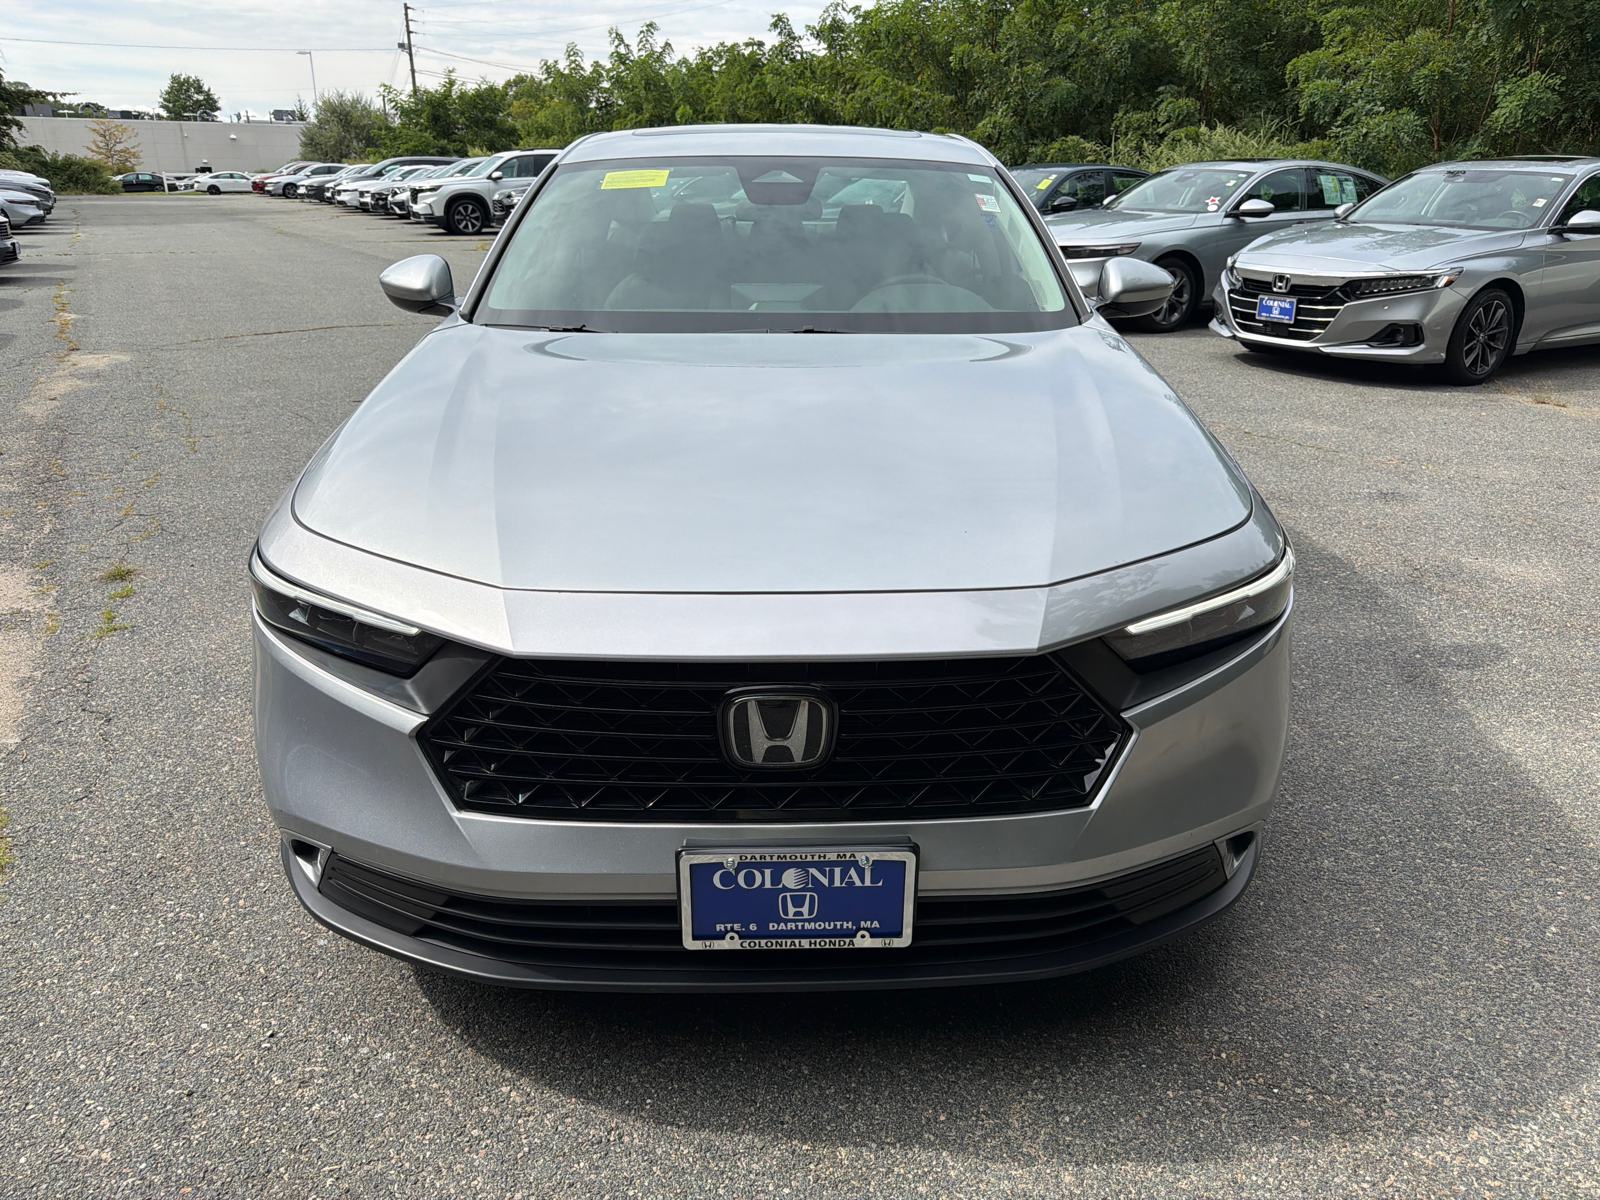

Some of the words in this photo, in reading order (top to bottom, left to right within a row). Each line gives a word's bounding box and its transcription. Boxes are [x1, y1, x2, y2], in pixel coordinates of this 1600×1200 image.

[739, 853, 831, 861] DARTMOUTH,
[712, 866, 884, 890] COLONIAL
[715, 923, 746, 931] RTE.
[749, 923, 757, 931] 6
[768, 921, 857, 931] DARTMOUTH,
[860, 920, 880, 929] MA
[740, 939, 805, 949] COLONIAL
[809, 938, 856, 948] HONDA
